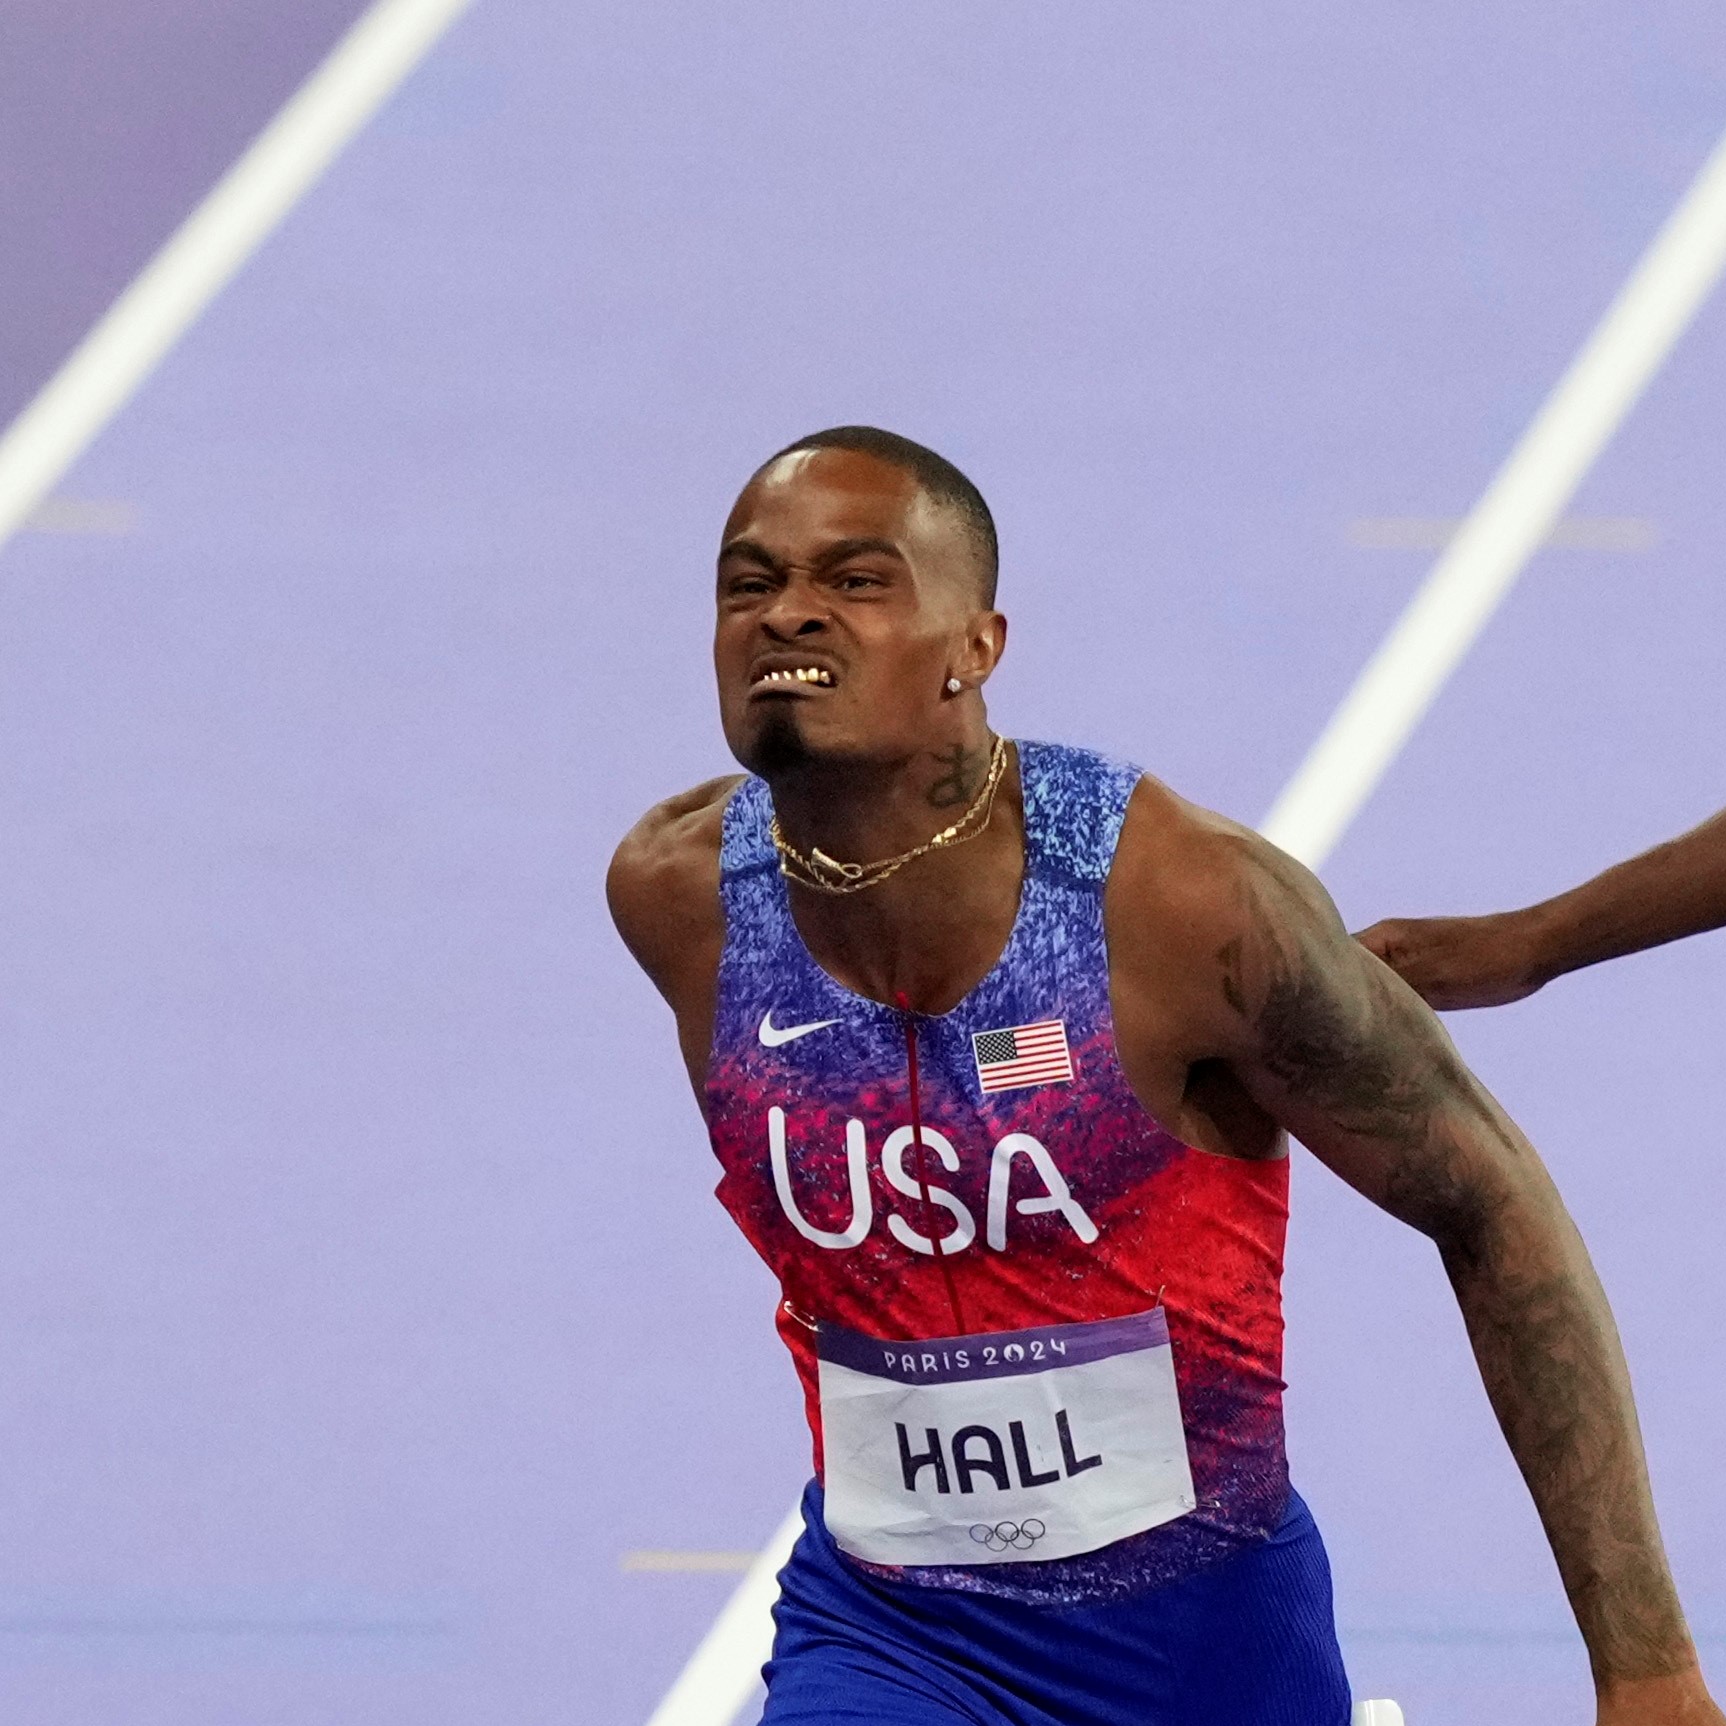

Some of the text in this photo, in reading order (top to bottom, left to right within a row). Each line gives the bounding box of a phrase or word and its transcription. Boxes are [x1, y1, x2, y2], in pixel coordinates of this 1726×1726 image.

[768, 1106, 1100, 1256] USA
[883, 1337, 1068, 1373] PARIS 2024
[894, 1409, 1104, 1496] HALL
